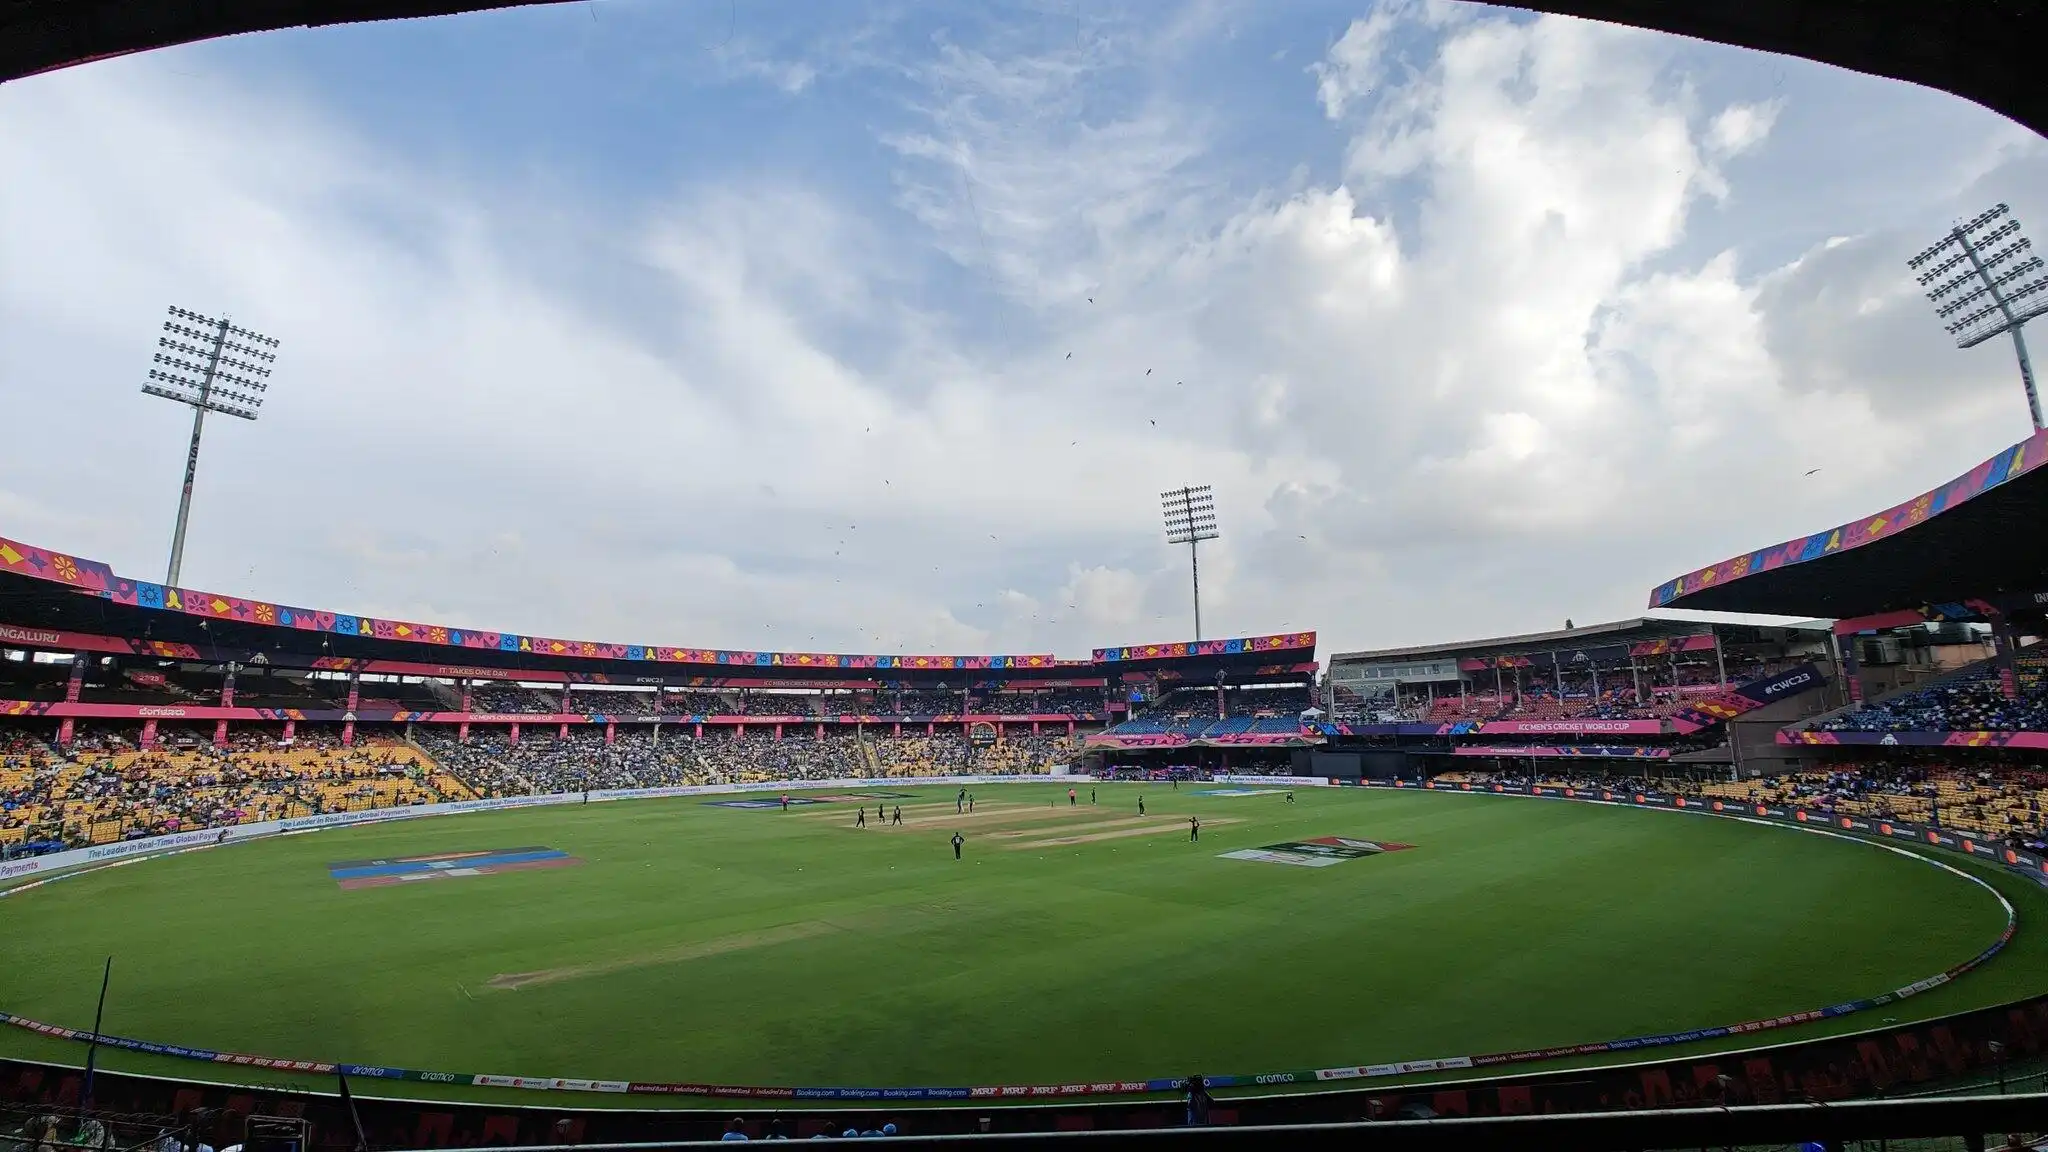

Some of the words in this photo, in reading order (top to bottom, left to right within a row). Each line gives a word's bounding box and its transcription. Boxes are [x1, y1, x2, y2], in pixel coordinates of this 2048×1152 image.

[449, 667, 474, 675] TAKES
[492, 669, 508, 677] DAY
[1765, 673, 1810, 695] #CWC23
[279, 821, 292, 829] The
[292, 819, 316, 827] Leader
[325, 814, 359, 823] Real-Time
[380, 808, 411, 817] Payments
[88, 849, 101, 859] The
[102, 845, 128, 857] Leader
[137, 838, 174, 851] Real-Time
[176, 834, 198, 845] Global
[0, 861, 39, 876] Payments
[293, 1061, 313, 1069] MRF
[314, 1063, 335, 1071] MRF
[352, 1065, 384, 1076] aramco
[420, 1072, 455, 1082] aramco
[1256, 1073, 1294, 1084] aramco
[796, 1089, 835, 1098] Booking.com
[840, 1089, 879, 1098] Booking.com
[883, 1089, 922, 1098] Booking.com
[928, 1089, 967, 1098] Booking.com
[971, 1087, 998, 1096] MRF
[1002, 1087, 1028, 1095] MRF
[1032, 1086, 1059, 1095] MRF
[1061, 1084, 1087, 1093] MRF
[1091, 1083, 1117, 1092] MRF
[1120, 1082, 1147, 1091] MRF
